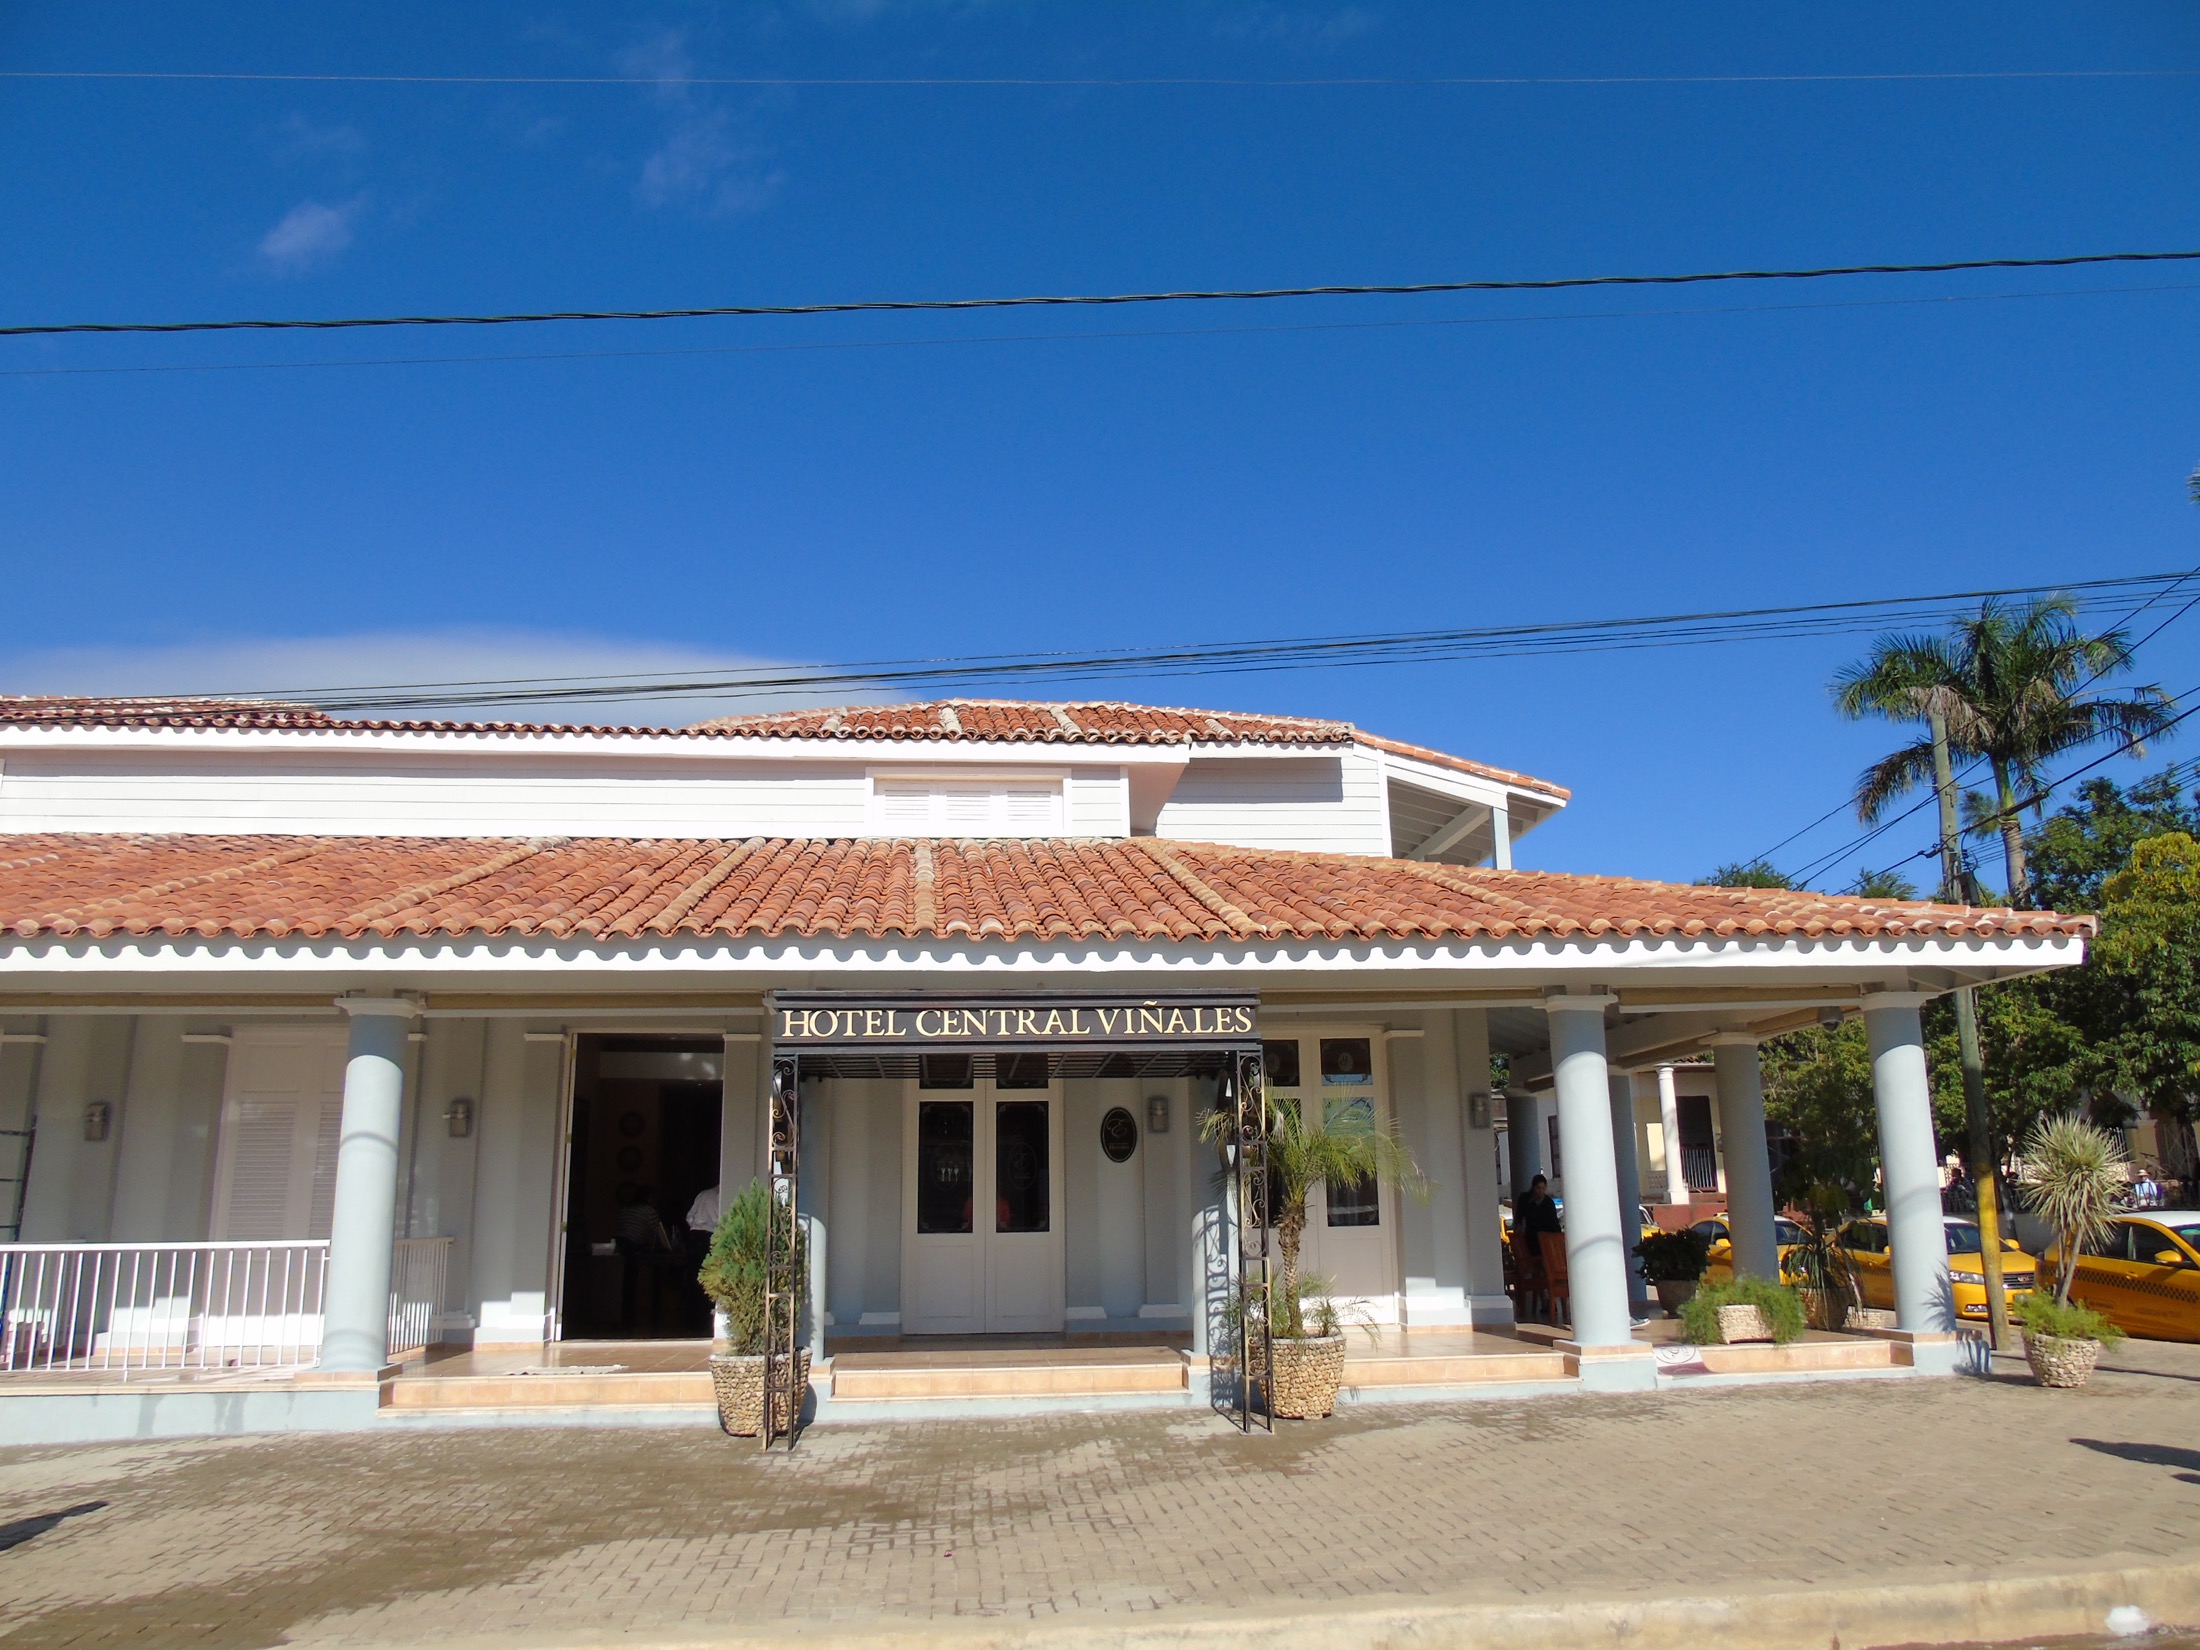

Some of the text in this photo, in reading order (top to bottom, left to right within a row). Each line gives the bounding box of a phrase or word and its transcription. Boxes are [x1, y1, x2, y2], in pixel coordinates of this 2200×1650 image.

[781, 1000, 1252, 1038] HOTEL CENTRAL VIÑALES
